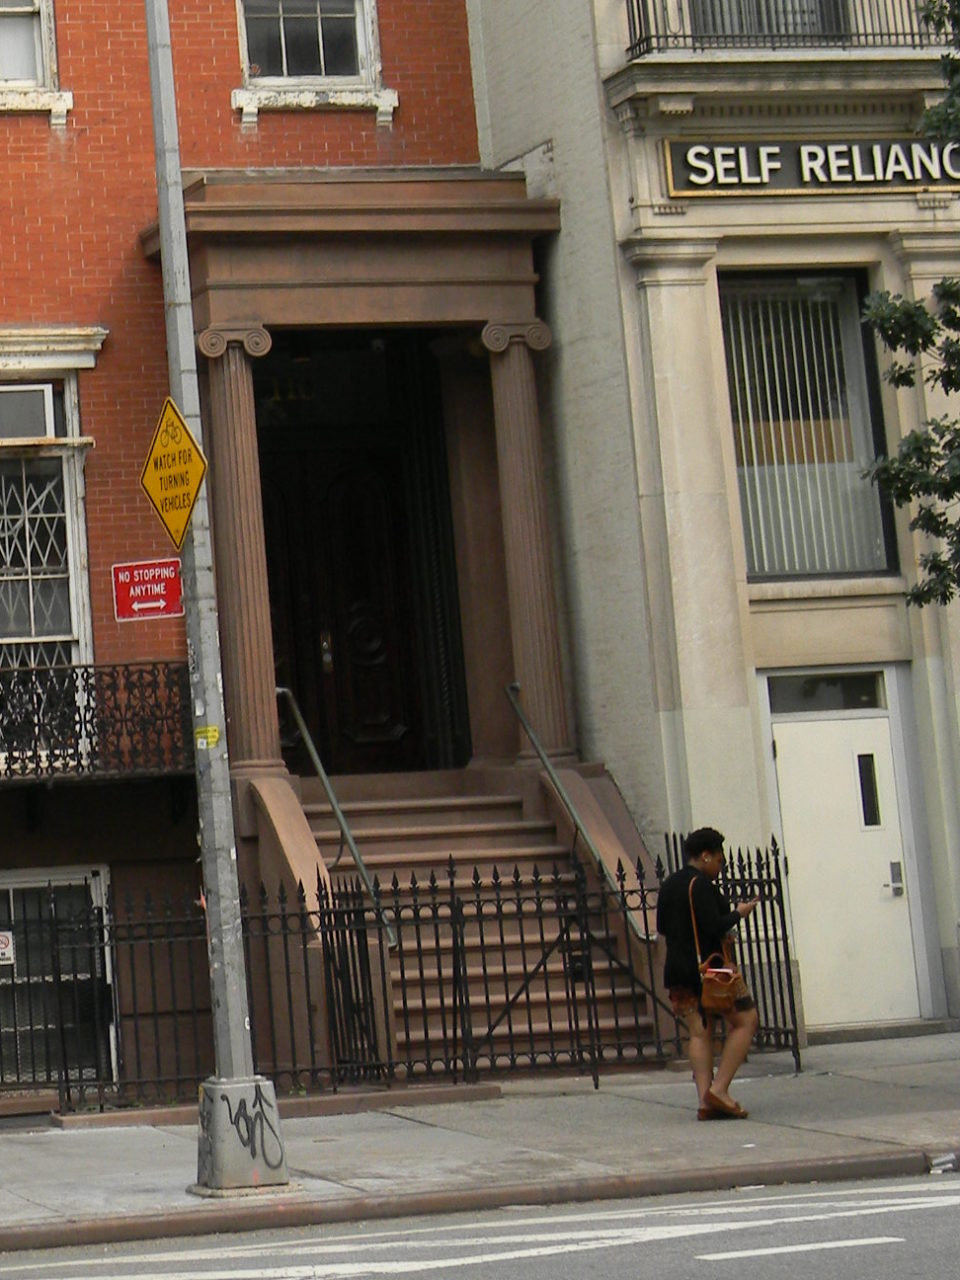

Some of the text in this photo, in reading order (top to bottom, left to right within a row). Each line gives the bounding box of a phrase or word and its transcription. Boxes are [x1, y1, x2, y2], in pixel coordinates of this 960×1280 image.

[686, 145, 781, 184] SELF
[152, 448, 193, 471] WATCH FOR
[159, 470, 190, 491] TURNING
[159, 492, 191, 513] VEHICLES
[118, 566, 175, 583] NO STOPPING
[129, 583, 166, 597] ANYTIME
